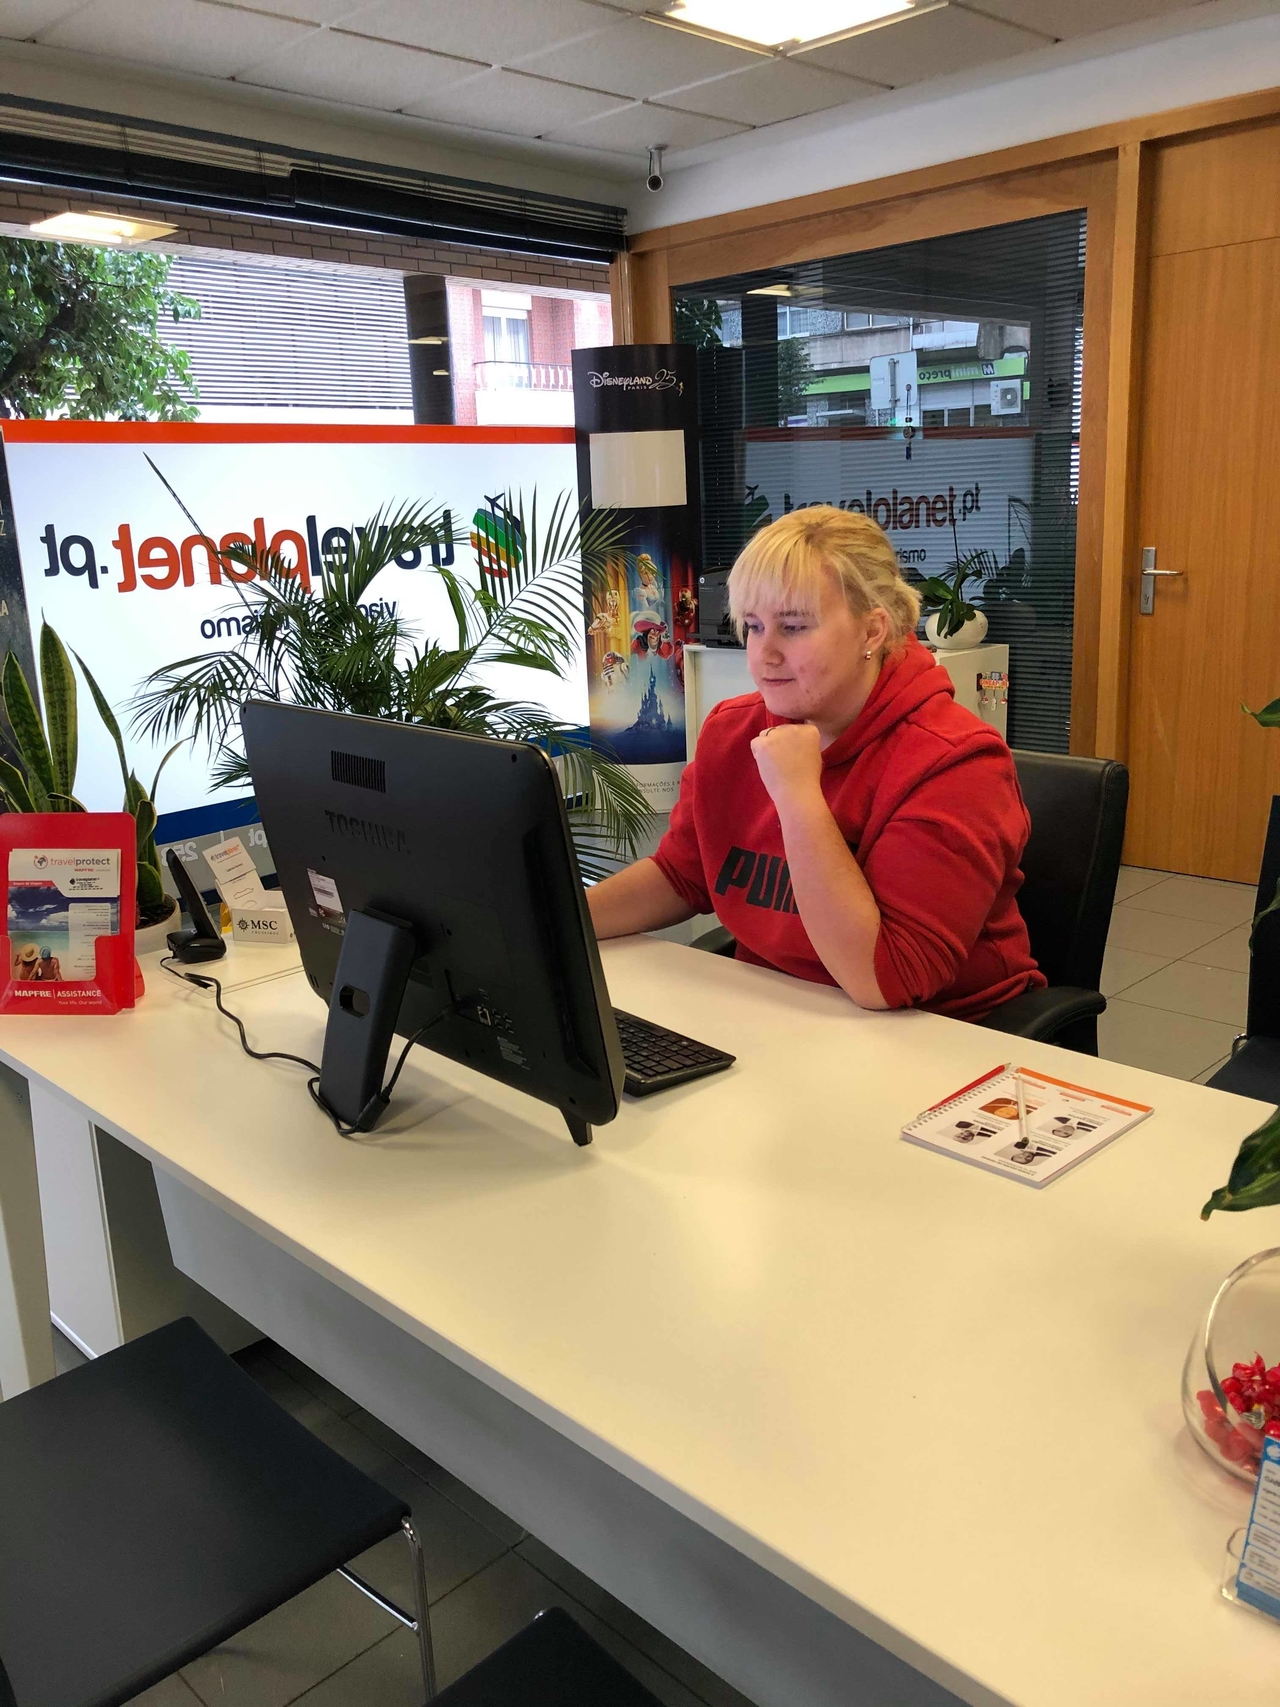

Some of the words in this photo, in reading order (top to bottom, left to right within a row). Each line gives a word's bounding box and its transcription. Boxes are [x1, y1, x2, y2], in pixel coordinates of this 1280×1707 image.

[50, 856, 111, 867] travelprotect
[250, 919, 278, 930] MSC
[14, 989, 52, 998] MAPFRE
[57, 989, 102, 998] ASSISTANCE
